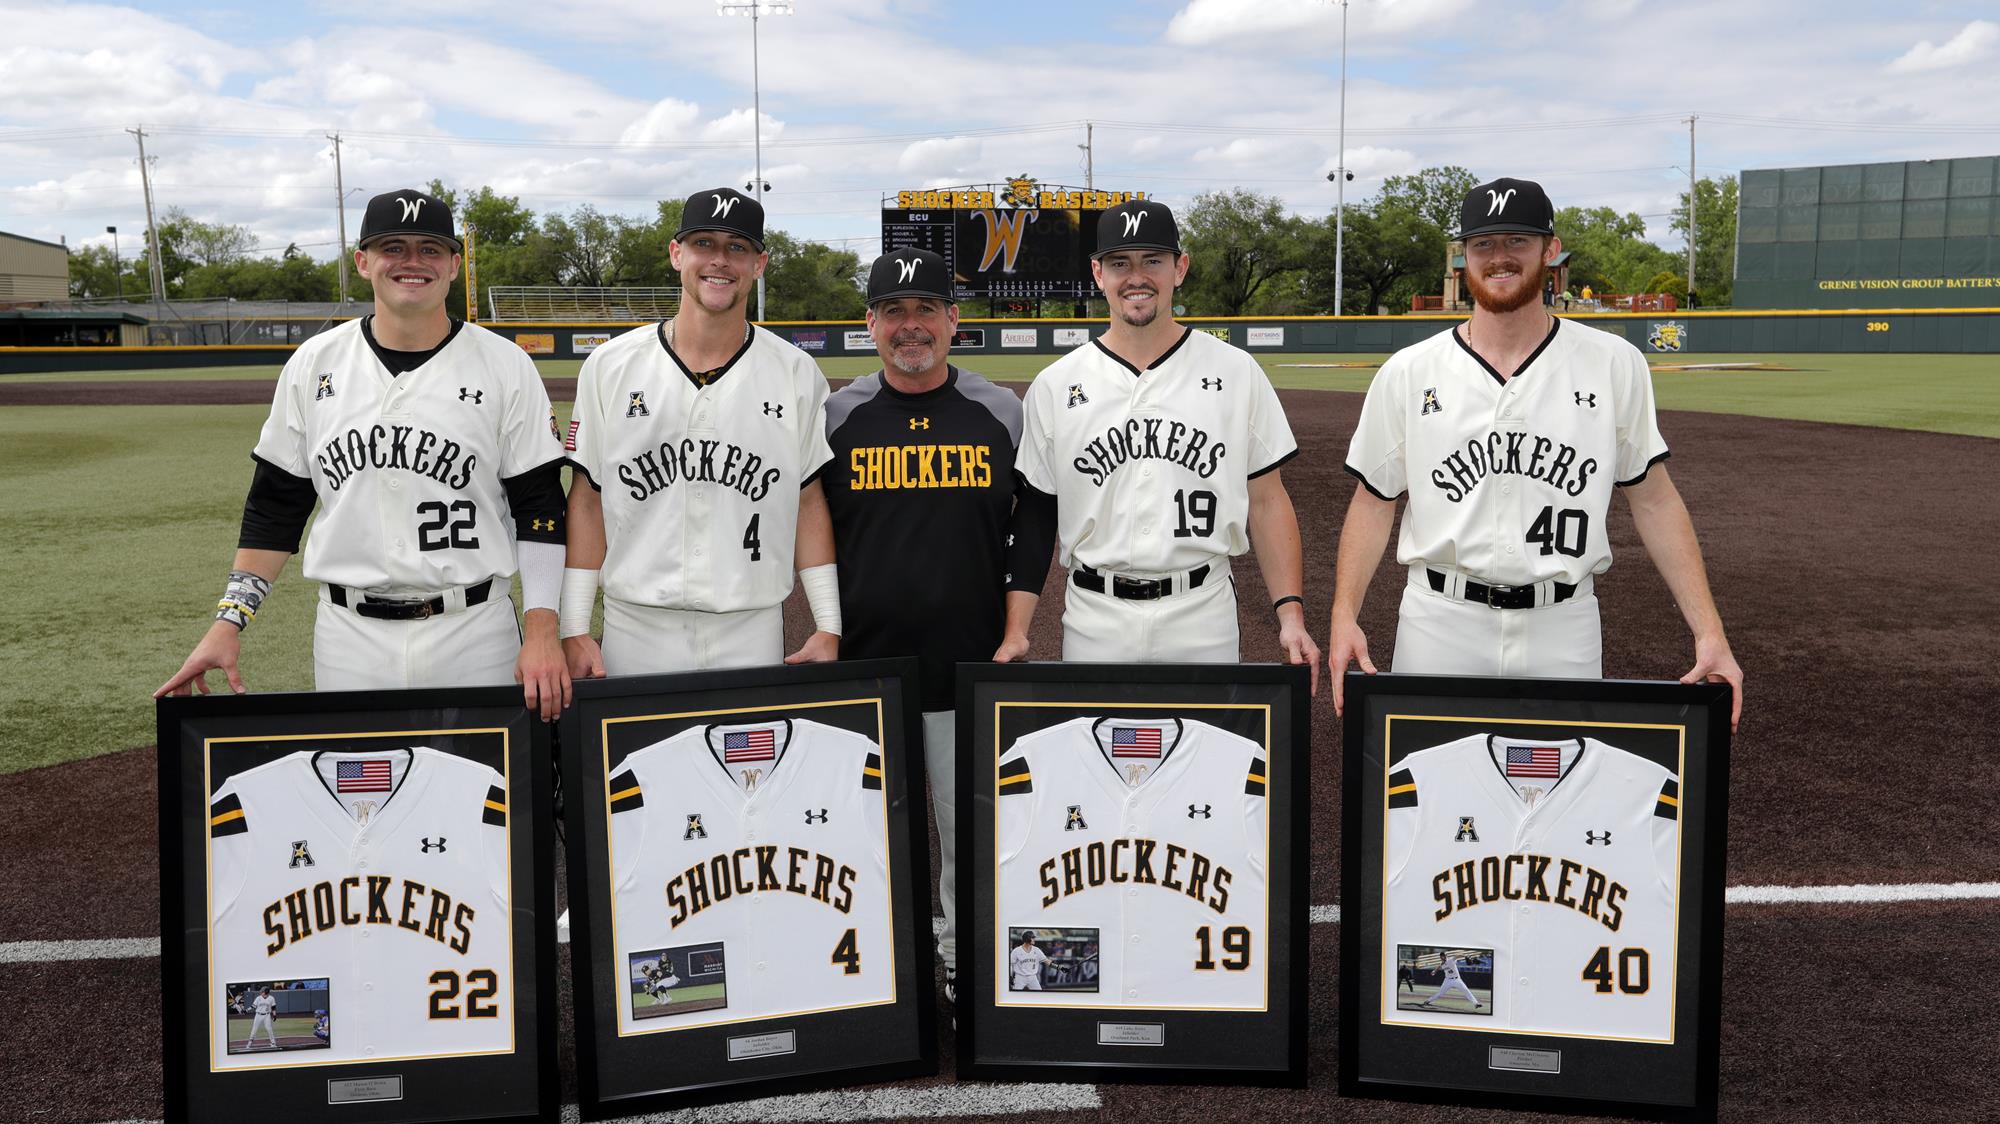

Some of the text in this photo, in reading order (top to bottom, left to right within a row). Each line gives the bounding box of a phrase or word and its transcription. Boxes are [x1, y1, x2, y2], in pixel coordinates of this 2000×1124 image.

[898, 191, 994, 209] SHOCKER
[1819, 278, 2000, 289] GRENE VISION GROUP BATTER'S
[1866, 322, 1889, 332] 390
[318, 424, 476, 491] SHOCKERS
[618, 438, 780, 502] SHOCKERS
[851, 445, 992, 490] SHOCKERS
[1073, 418, 1226, 487] SHOCKERS
[1432, 431, 1597, 503] SHOCKERS
[416, 500, 480, 552] 22
[743, 513, 761, 561] 4
[1173, 489, 1217, 538] 19
[1526, 505, 1588, 558] 40
[665, 845, 857, 930] SHOCKERS
[1039, 838, 1233, 914] SHOCKERS
[1432, 854, 1628, 933] SHOCKERS
[263, 875, 474, 958] SHOCKERS
[831, 928, 862, 976] 4
[1194, 925, 1251, 971] 19
[1581, 946, 1650, 995] 40
[428, 968, 498, 1020] 22
